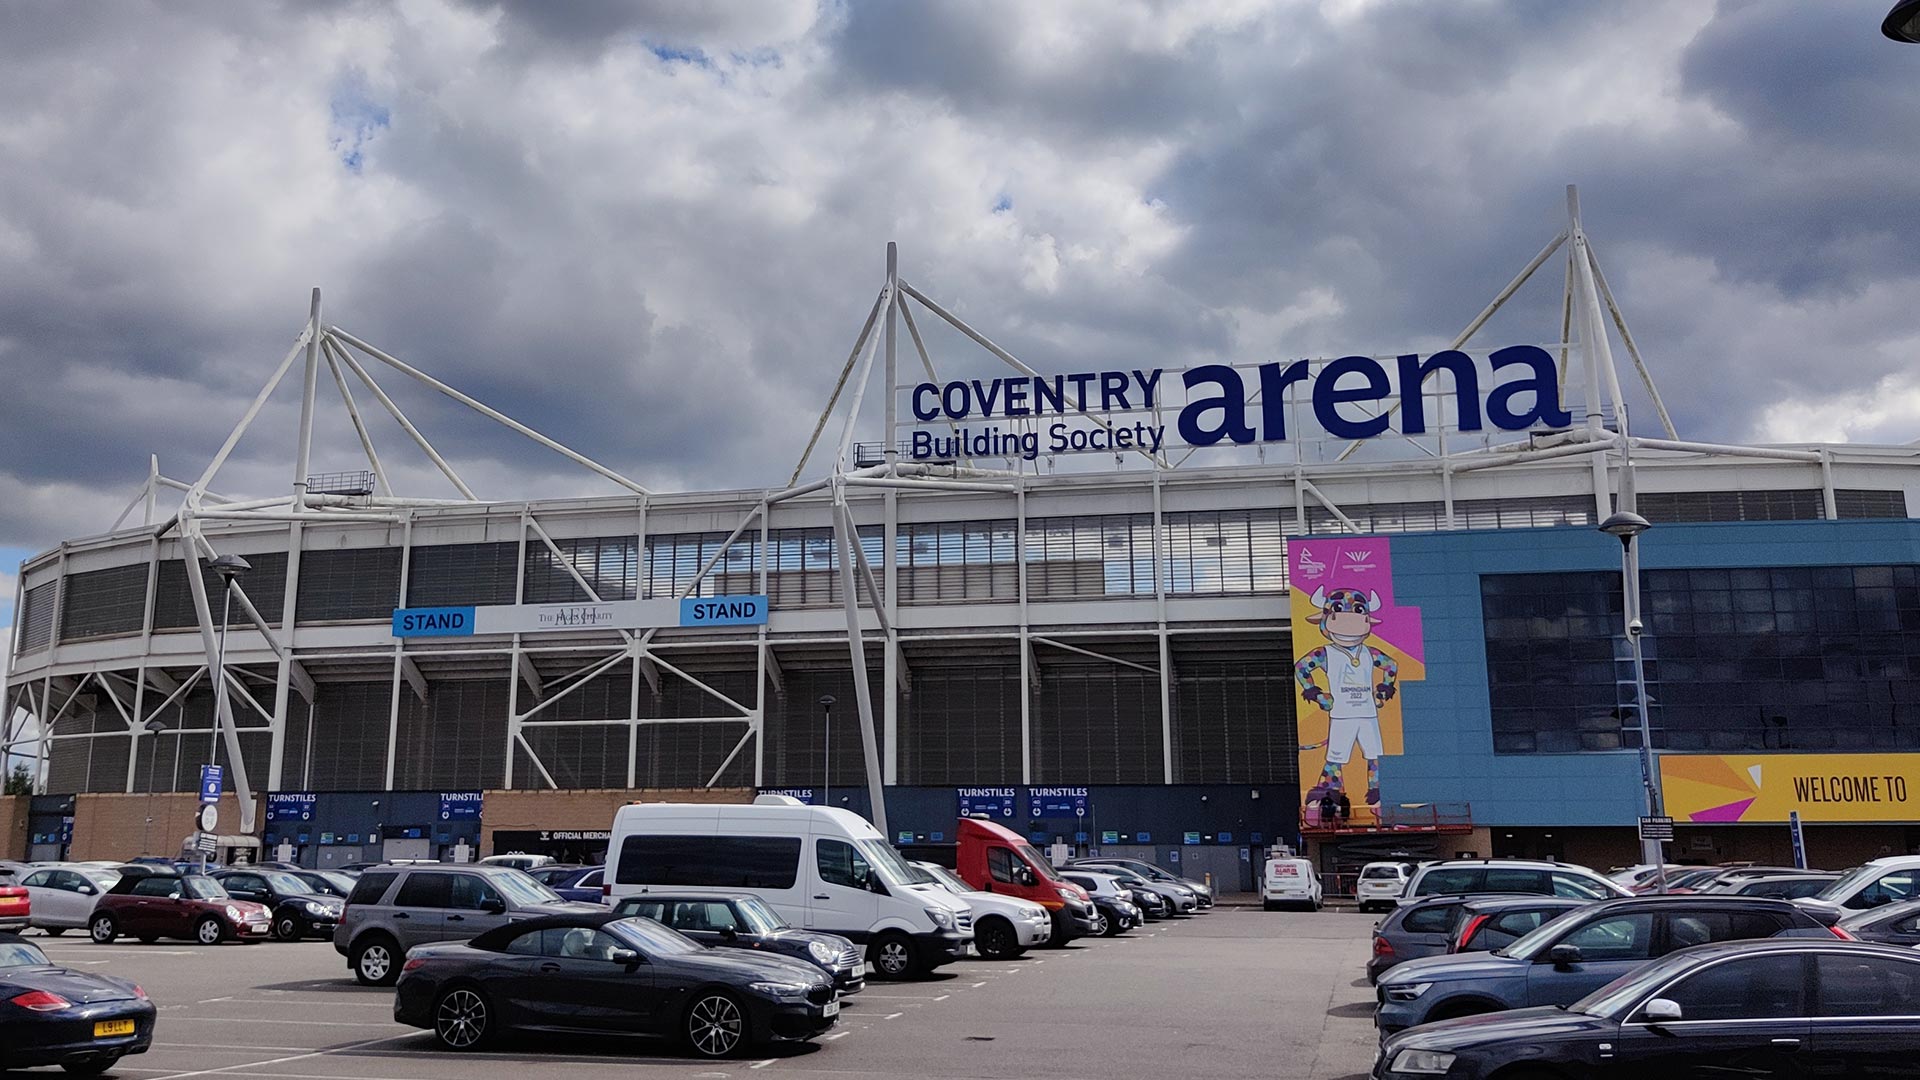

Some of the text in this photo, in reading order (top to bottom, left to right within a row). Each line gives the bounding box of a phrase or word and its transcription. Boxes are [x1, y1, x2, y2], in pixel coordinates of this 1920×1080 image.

[912, 345, 1572, 446] COVENTRY arena
[912, 420, 1165, 461] Building Society
[693, 602, 756, 620] STAND
[403, 613, 464, 631] STAND
[268, 794, 316, 802] TURNSTILES
[957, 788, 1015, 797] TURNSTILES
[1029, 788, 1088, 797] TURNSTILES
[1793, 776, 1907, 802] WELCOME TO
[553, 832, 582, 840] OFFICIAL
